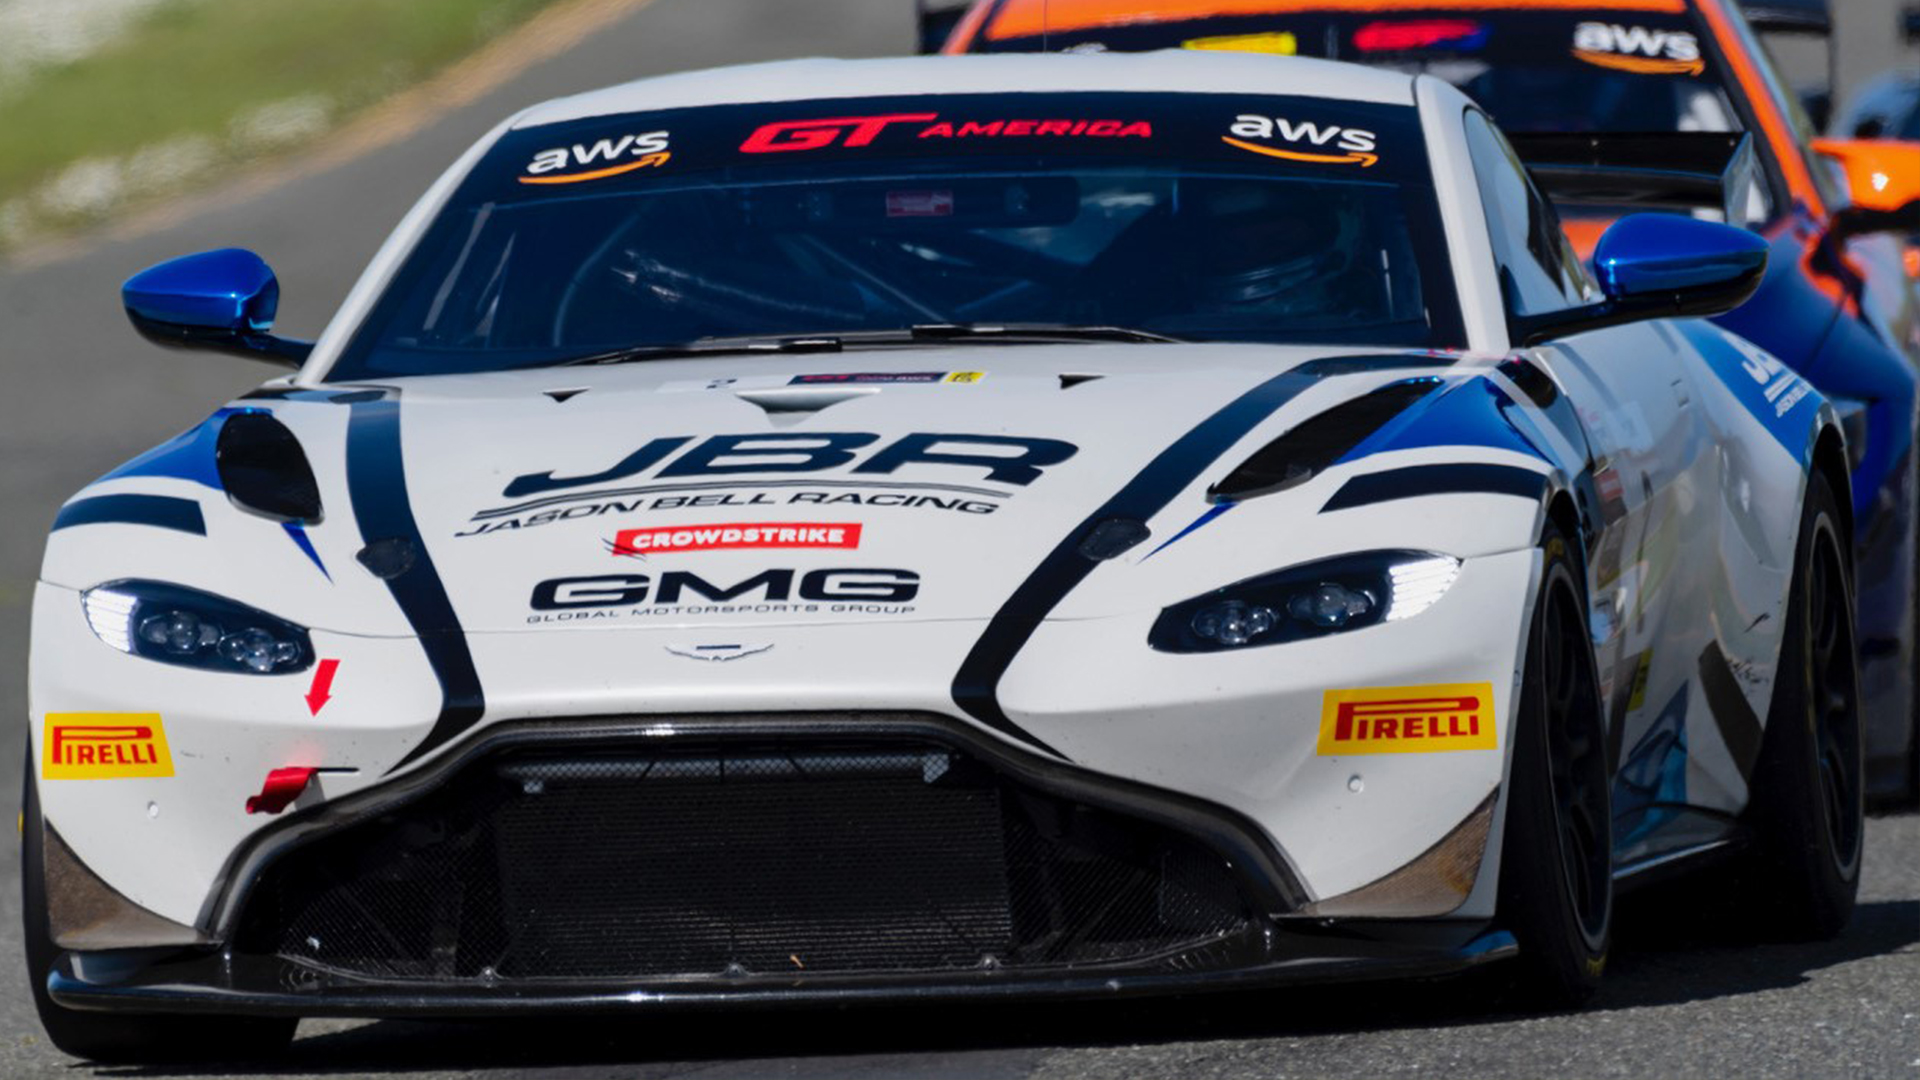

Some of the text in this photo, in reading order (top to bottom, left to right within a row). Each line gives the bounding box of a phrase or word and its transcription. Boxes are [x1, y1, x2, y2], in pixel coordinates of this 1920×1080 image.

[1573, 21, 1700, 61] aws
[526, 130, 670, 175] aws
[738, 112, 1153, 154] GT AMERICA
[1229, 113, 1377, 153] aws
[502, 431, 1080, 498] JBR
[453, 492, 1000, 538] JASON BELL RACING
[631, 526, 846, 549] CROWDSTRIKE
[529, 567, 921, 612] GMG
[526, 603, 917, 625] GLOBAL MOTORSPORTS GROUP
[1333, 695, 1481, 742] PIRELLI
[51, 725, 159, 766] PIRELLI
